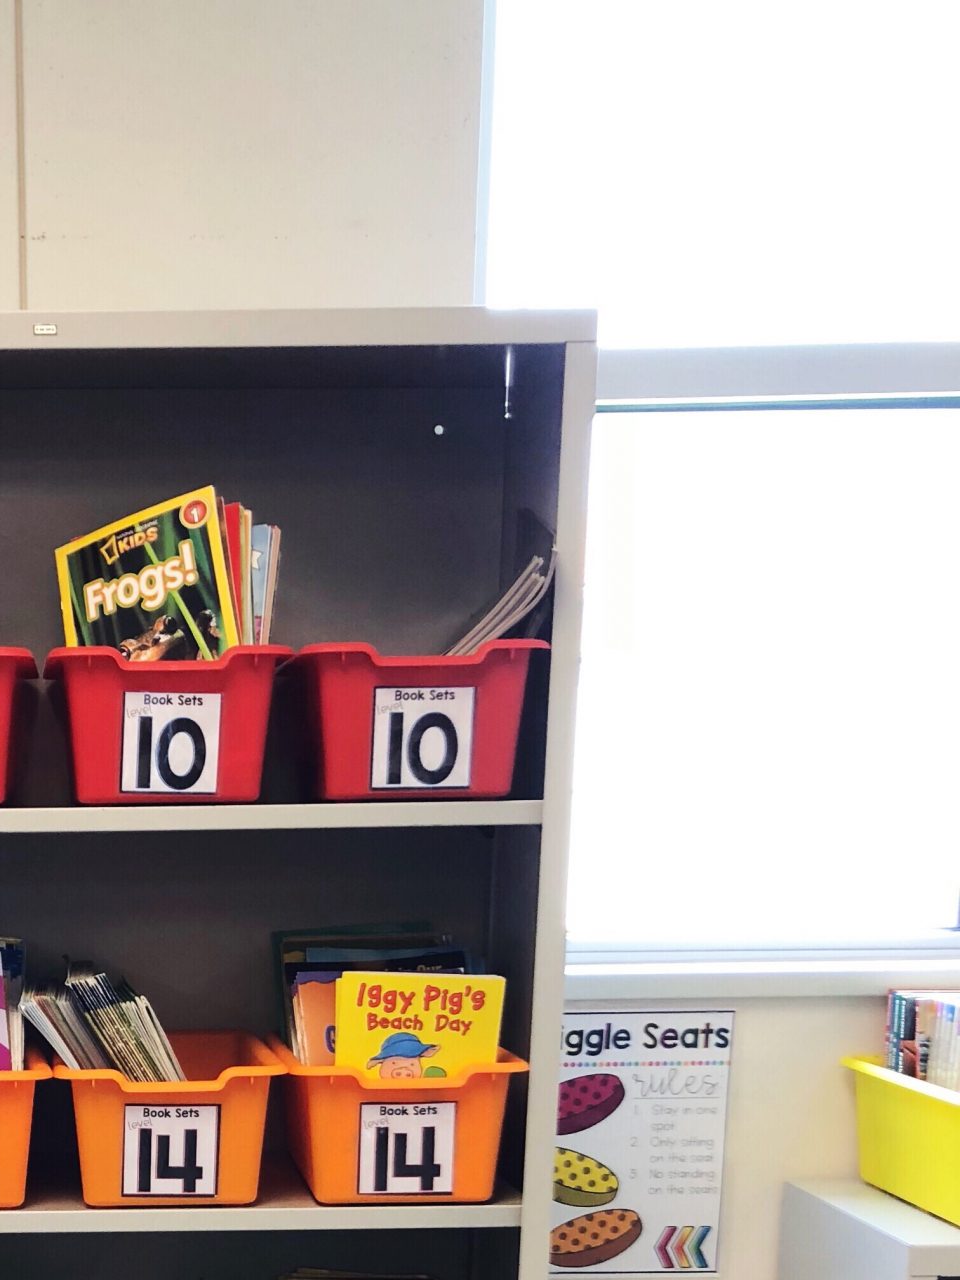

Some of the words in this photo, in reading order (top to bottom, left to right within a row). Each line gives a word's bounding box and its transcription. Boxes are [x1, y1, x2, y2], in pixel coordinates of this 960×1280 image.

[190, 508, 200, 523] 1
[117, 526, 159, 555] KIDS
[84, 539, 199, 622] Frogs!
[143, 695, 173, 706] Book
[178, 695, 204, 706] Sets
[395, 690, 425, 701] Book
[430, 689, 456, 701] Sets
[136, 716, 207, 790] 10
[386, 711, 459, 785] 10
[357, 982, 416, 1014] Iggy
[423, 984, 486, 1015] Pig's
[367, 1012, 424, 1032] Beach
[435, 1014, 473, 1036] Day
[643, 1023, 730, 1050] Seats
[632, 1068, 719, 1096] rules
[143, 1108, 172, 1119] Book
[175, 1107, 200, 1119] Sets
[379, 1106, 409, 1116] Book
[413, 1105, 438, 1116] Sets
[137, 1128, 203, 1193] 14
[374, 1126, 441, 1191] 14
